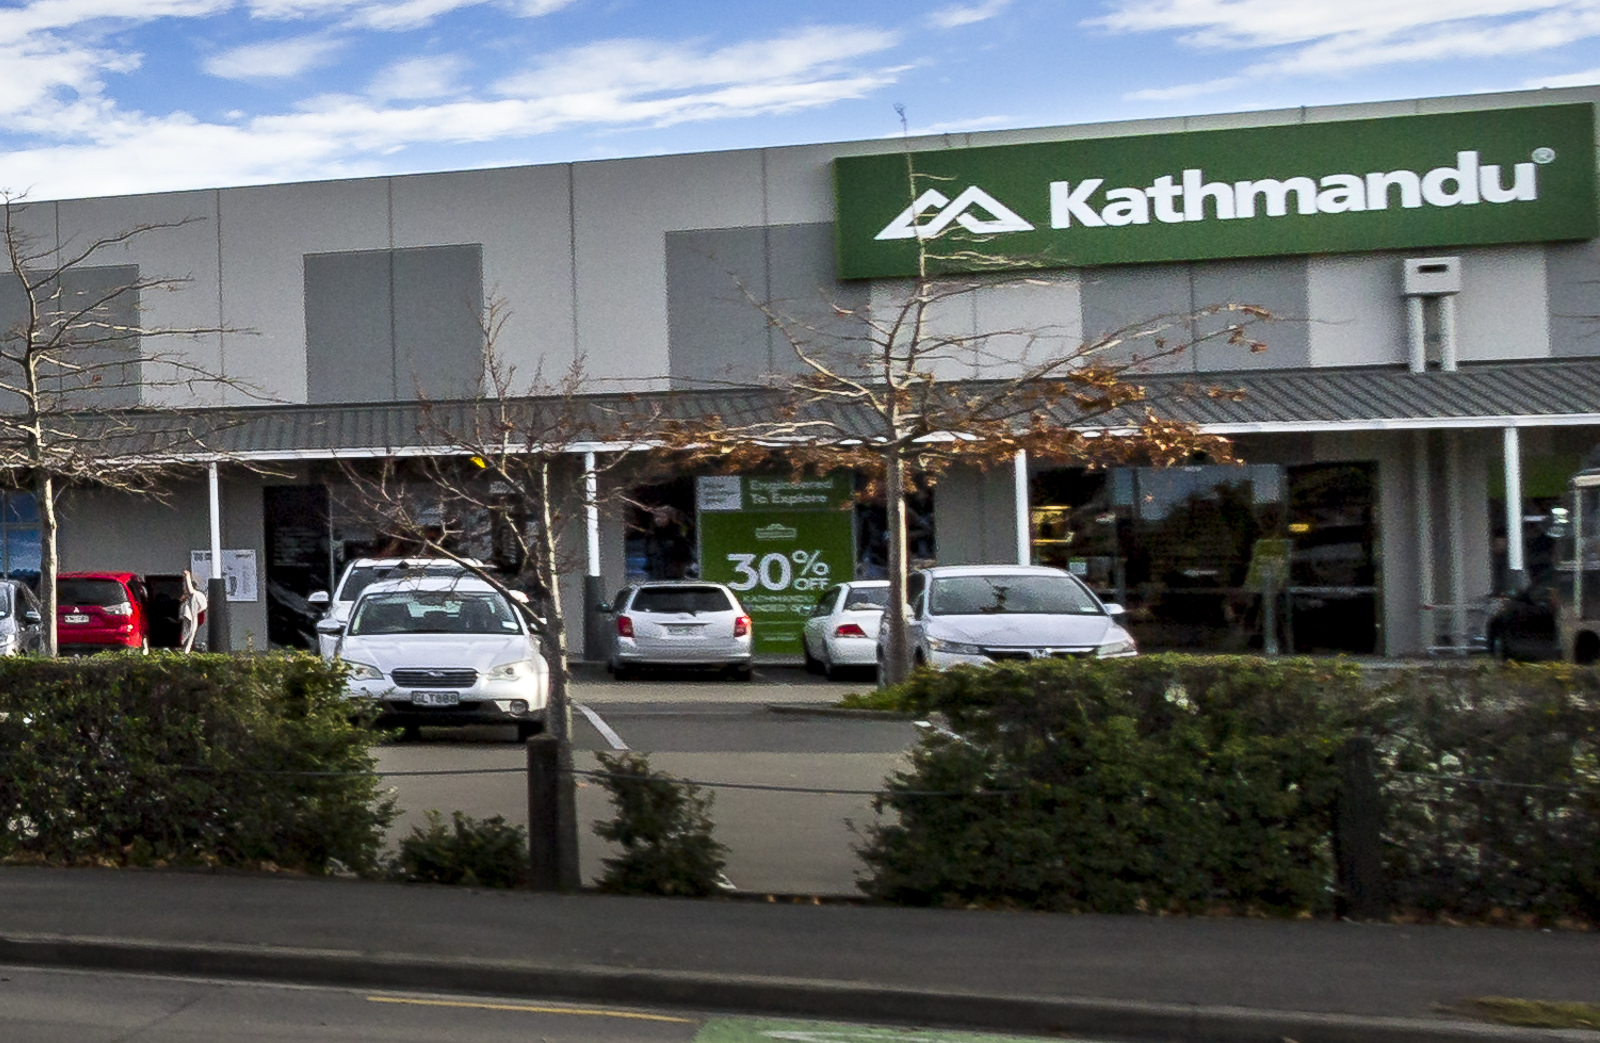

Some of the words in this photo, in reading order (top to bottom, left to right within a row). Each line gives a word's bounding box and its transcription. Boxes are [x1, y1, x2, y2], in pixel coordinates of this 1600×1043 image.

[1049, 150, 1538, 229] Kathmandu
[727, 549, 830, 591] 30%
[793, 577, 829, 591] OFF
